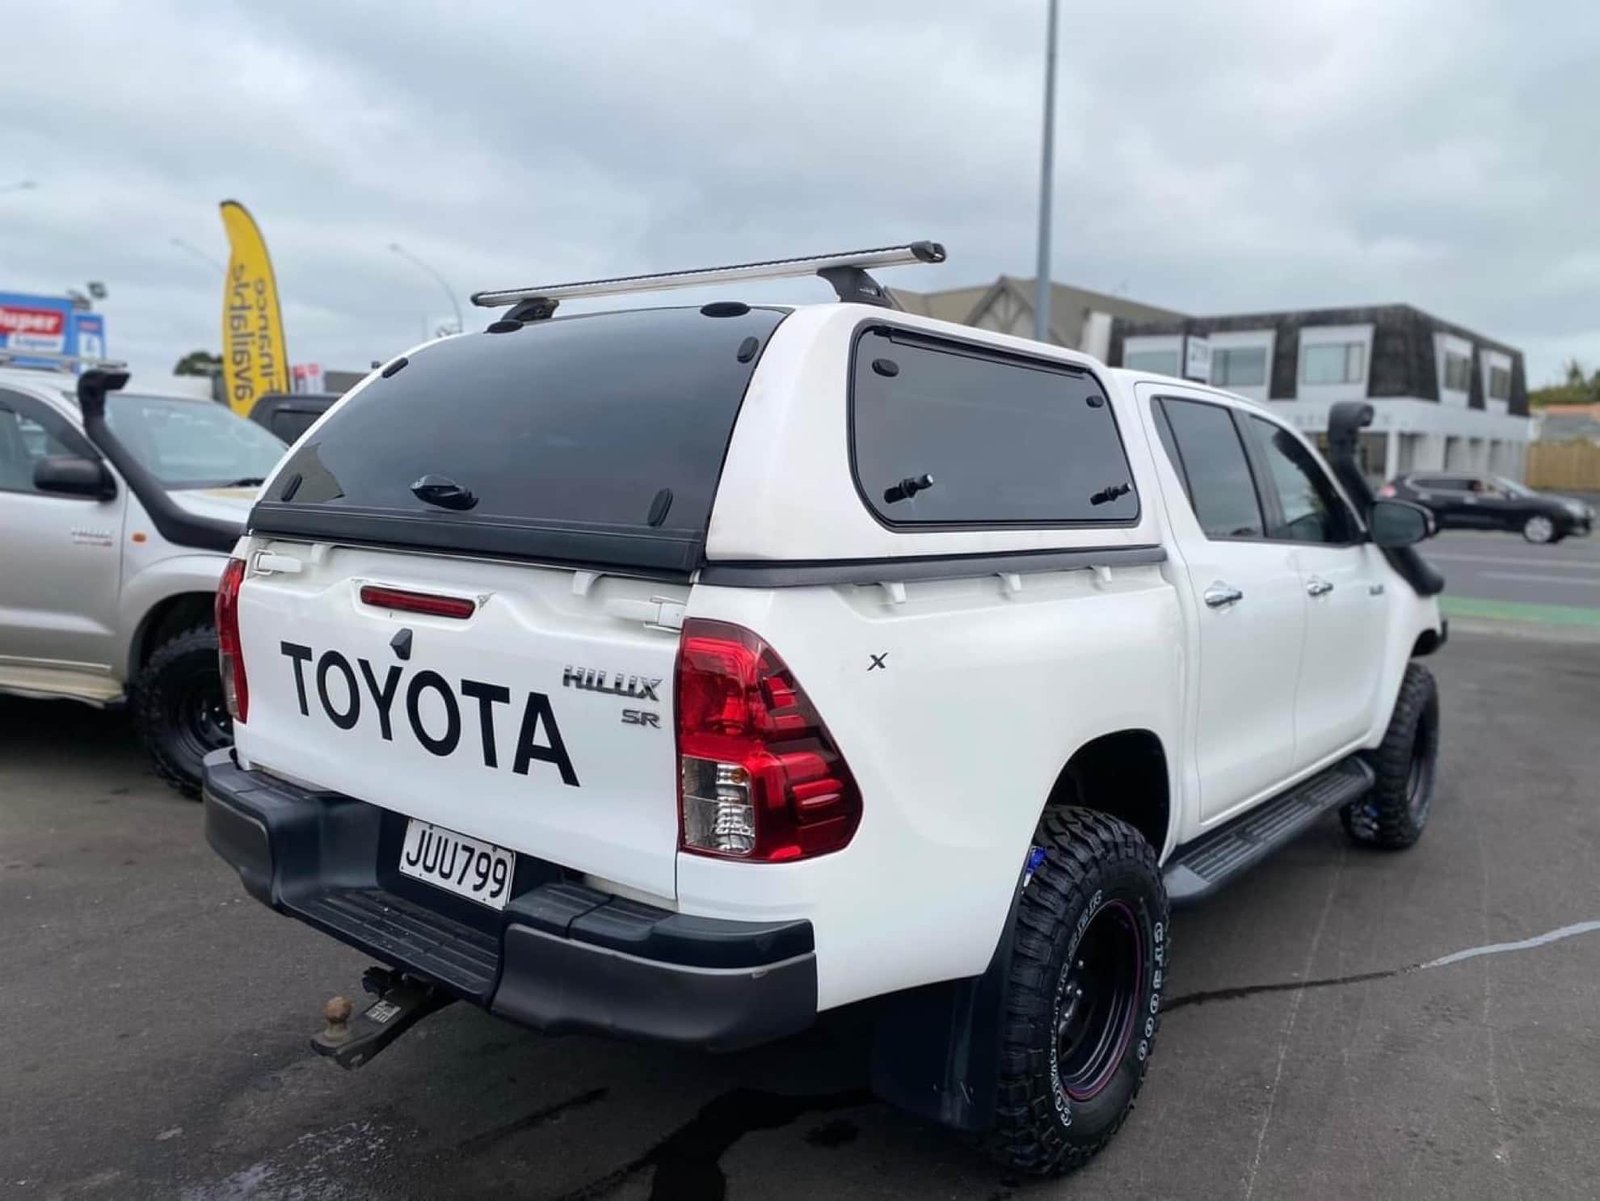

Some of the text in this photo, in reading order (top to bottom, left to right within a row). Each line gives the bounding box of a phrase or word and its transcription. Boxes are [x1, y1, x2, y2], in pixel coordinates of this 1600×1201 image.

[563, 665, 663, 701] HILUX
[281, 641, 580, 787] TOYOTA
[621, 709, 661, 729] SR
[406, 830, 507, 898] JUU799
